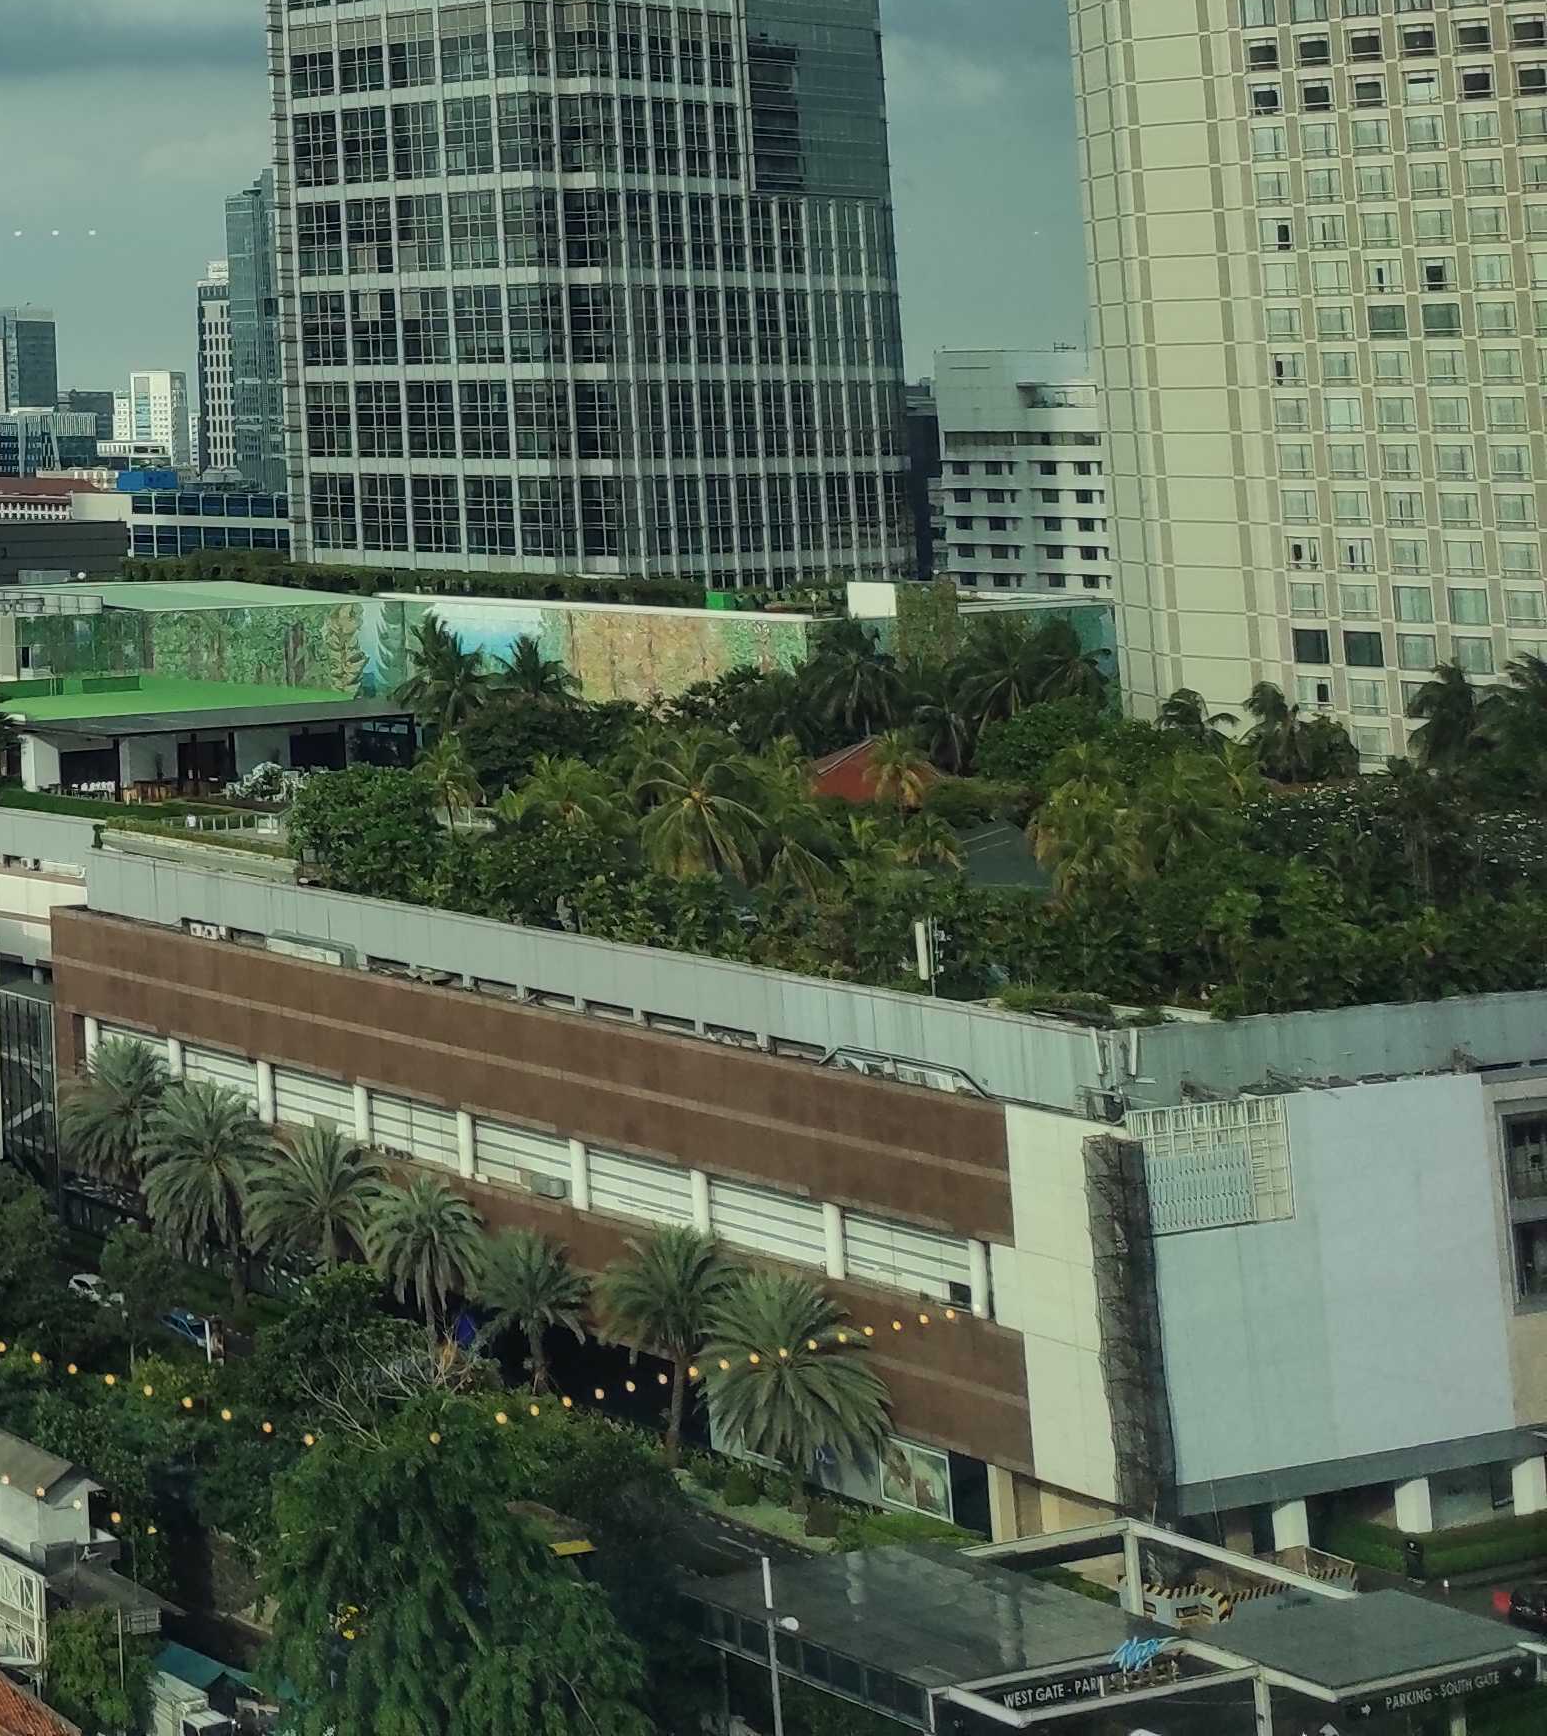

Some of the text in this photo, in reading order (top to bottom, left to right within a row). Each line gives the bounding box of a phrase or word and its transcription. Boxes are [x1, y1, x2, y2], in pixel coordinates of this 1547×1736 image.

[1004, 1689, 1033, 1708] WEST
[1036, 1684, 1064, 1702] GATE
[1385, 1688, 1431, 1710] PARKING
[1440, 1679, 1473, 1697] SOUTH
[1475, 1672, 1499, 1688] GATE
